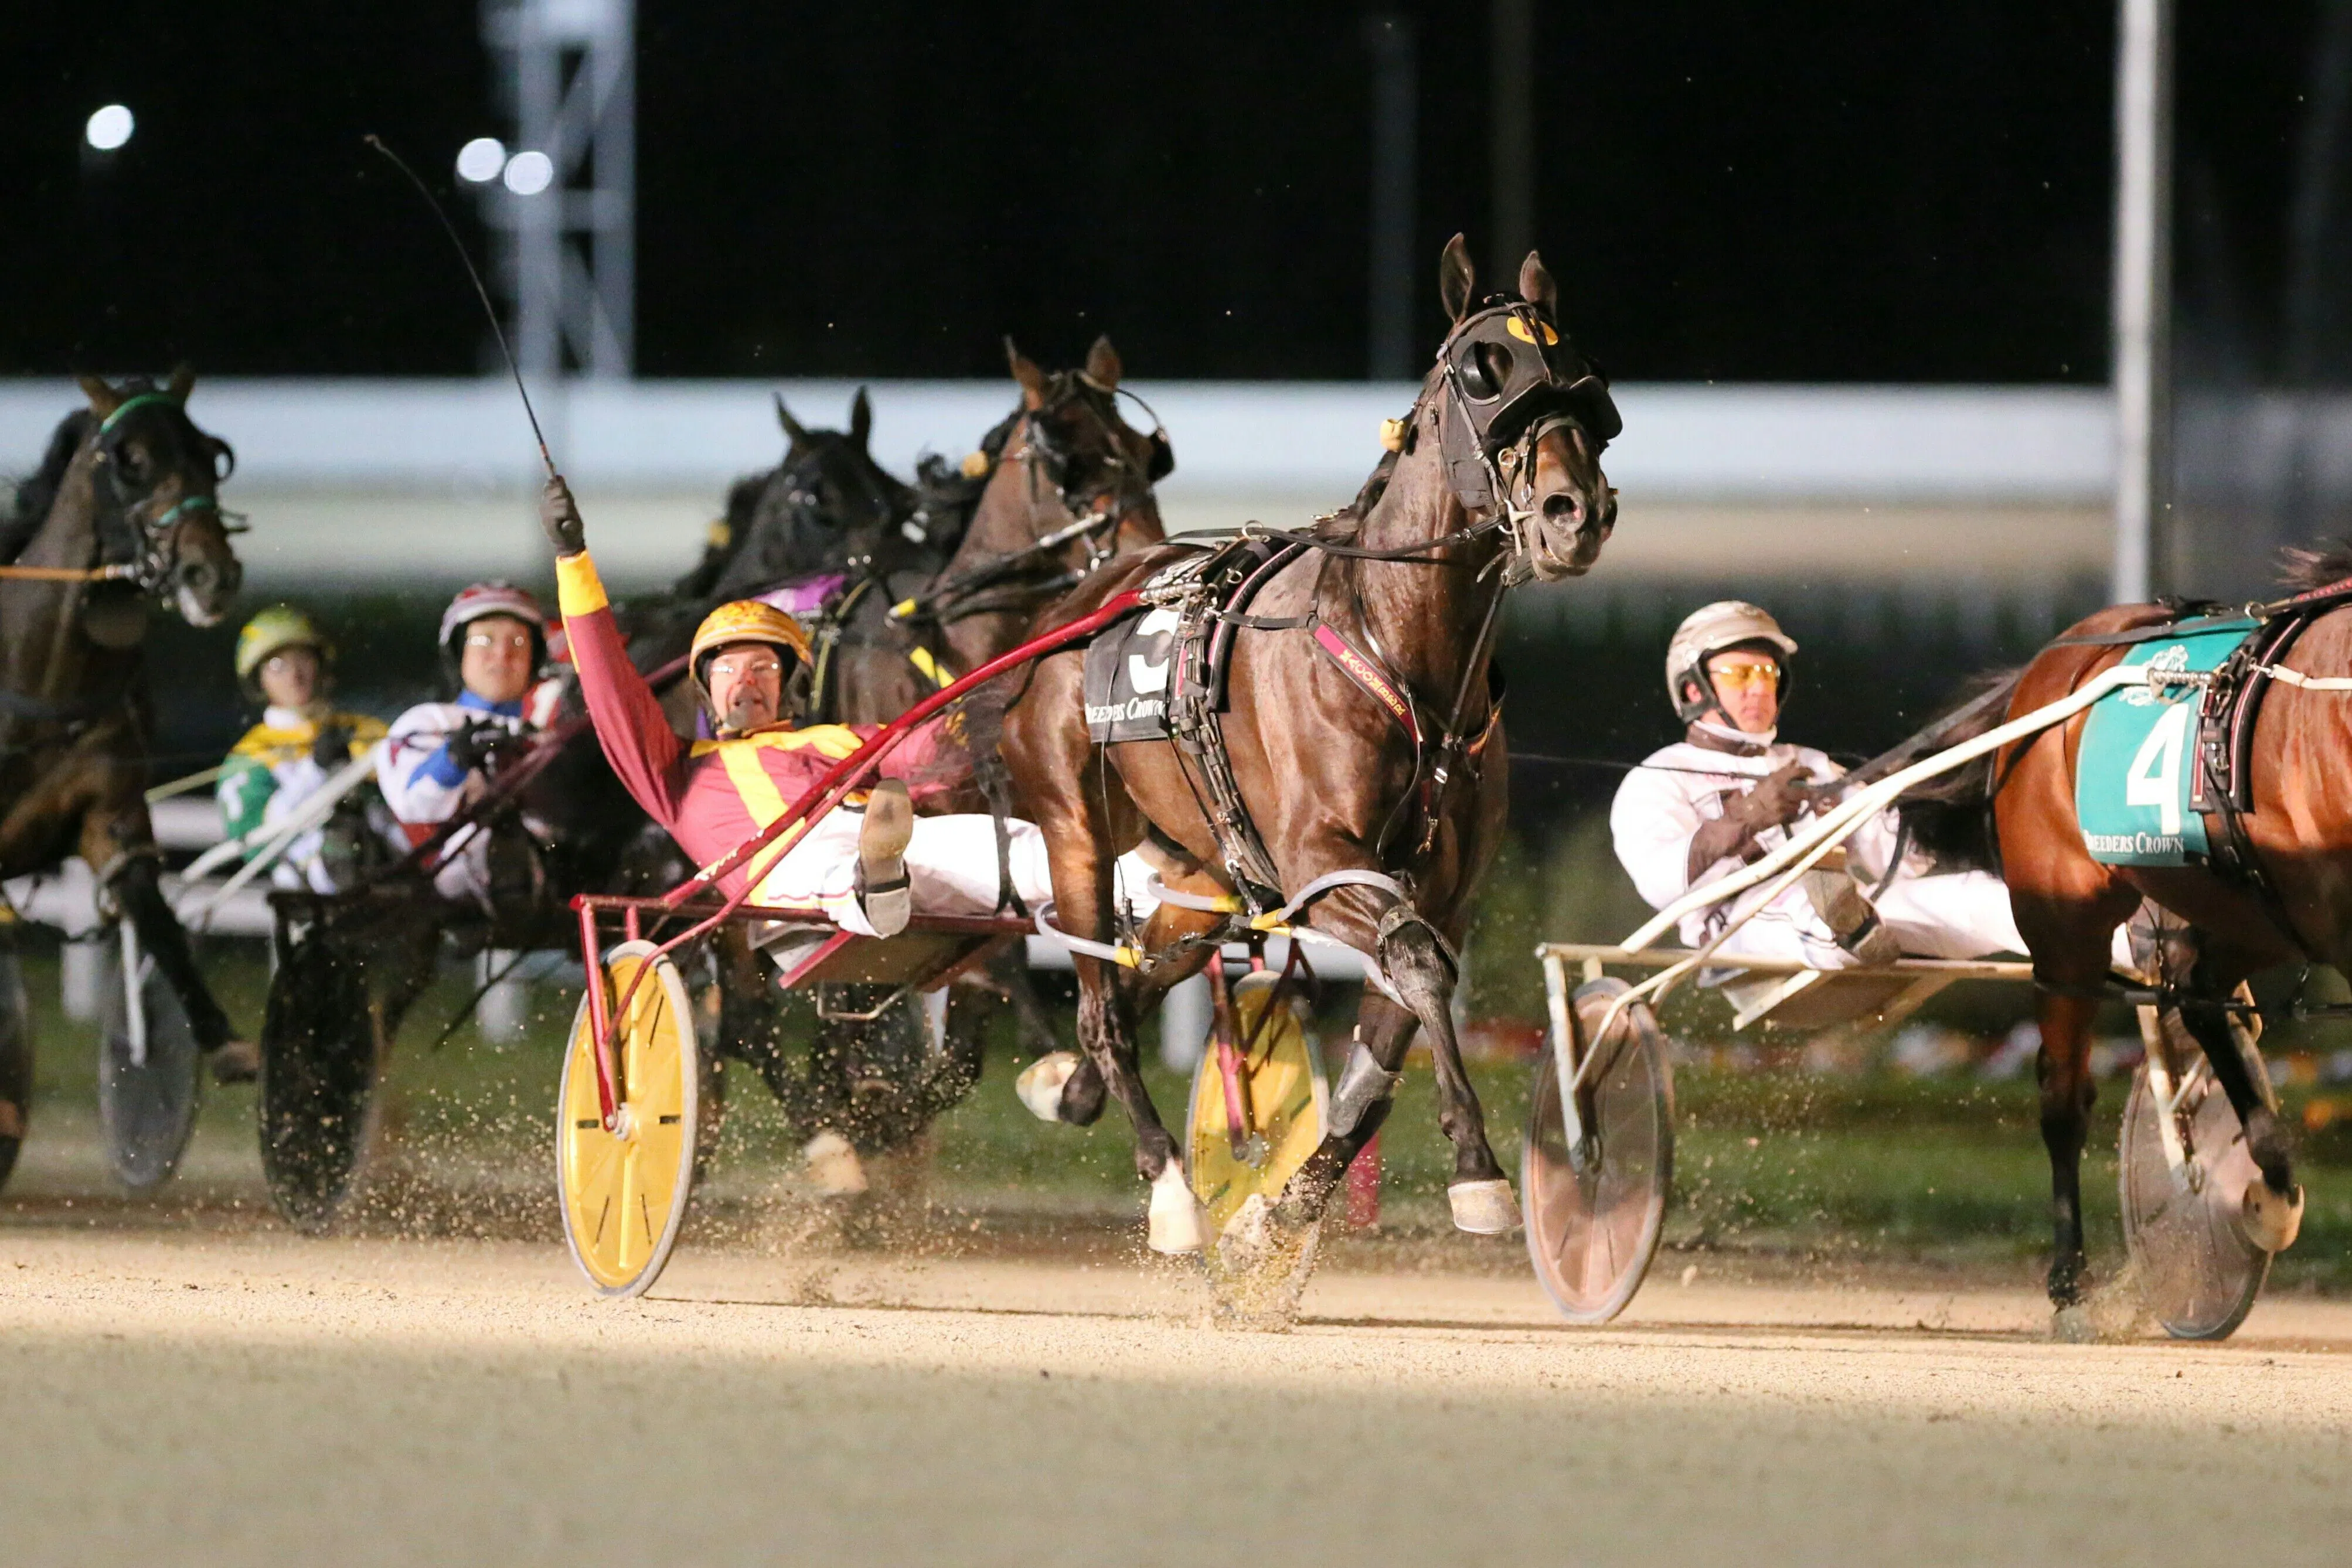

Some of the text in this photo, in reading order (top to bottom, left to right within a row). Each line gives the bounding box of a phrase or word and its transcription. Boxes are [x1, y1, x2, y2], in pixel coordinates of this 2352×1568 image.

[1129, 608, 1180, 694] 3
[1339, 649, 1406, 717] MACOMBER
[2126, 703, 2189, 835] 4
[2135, 831, 2184, 854] CROWN
